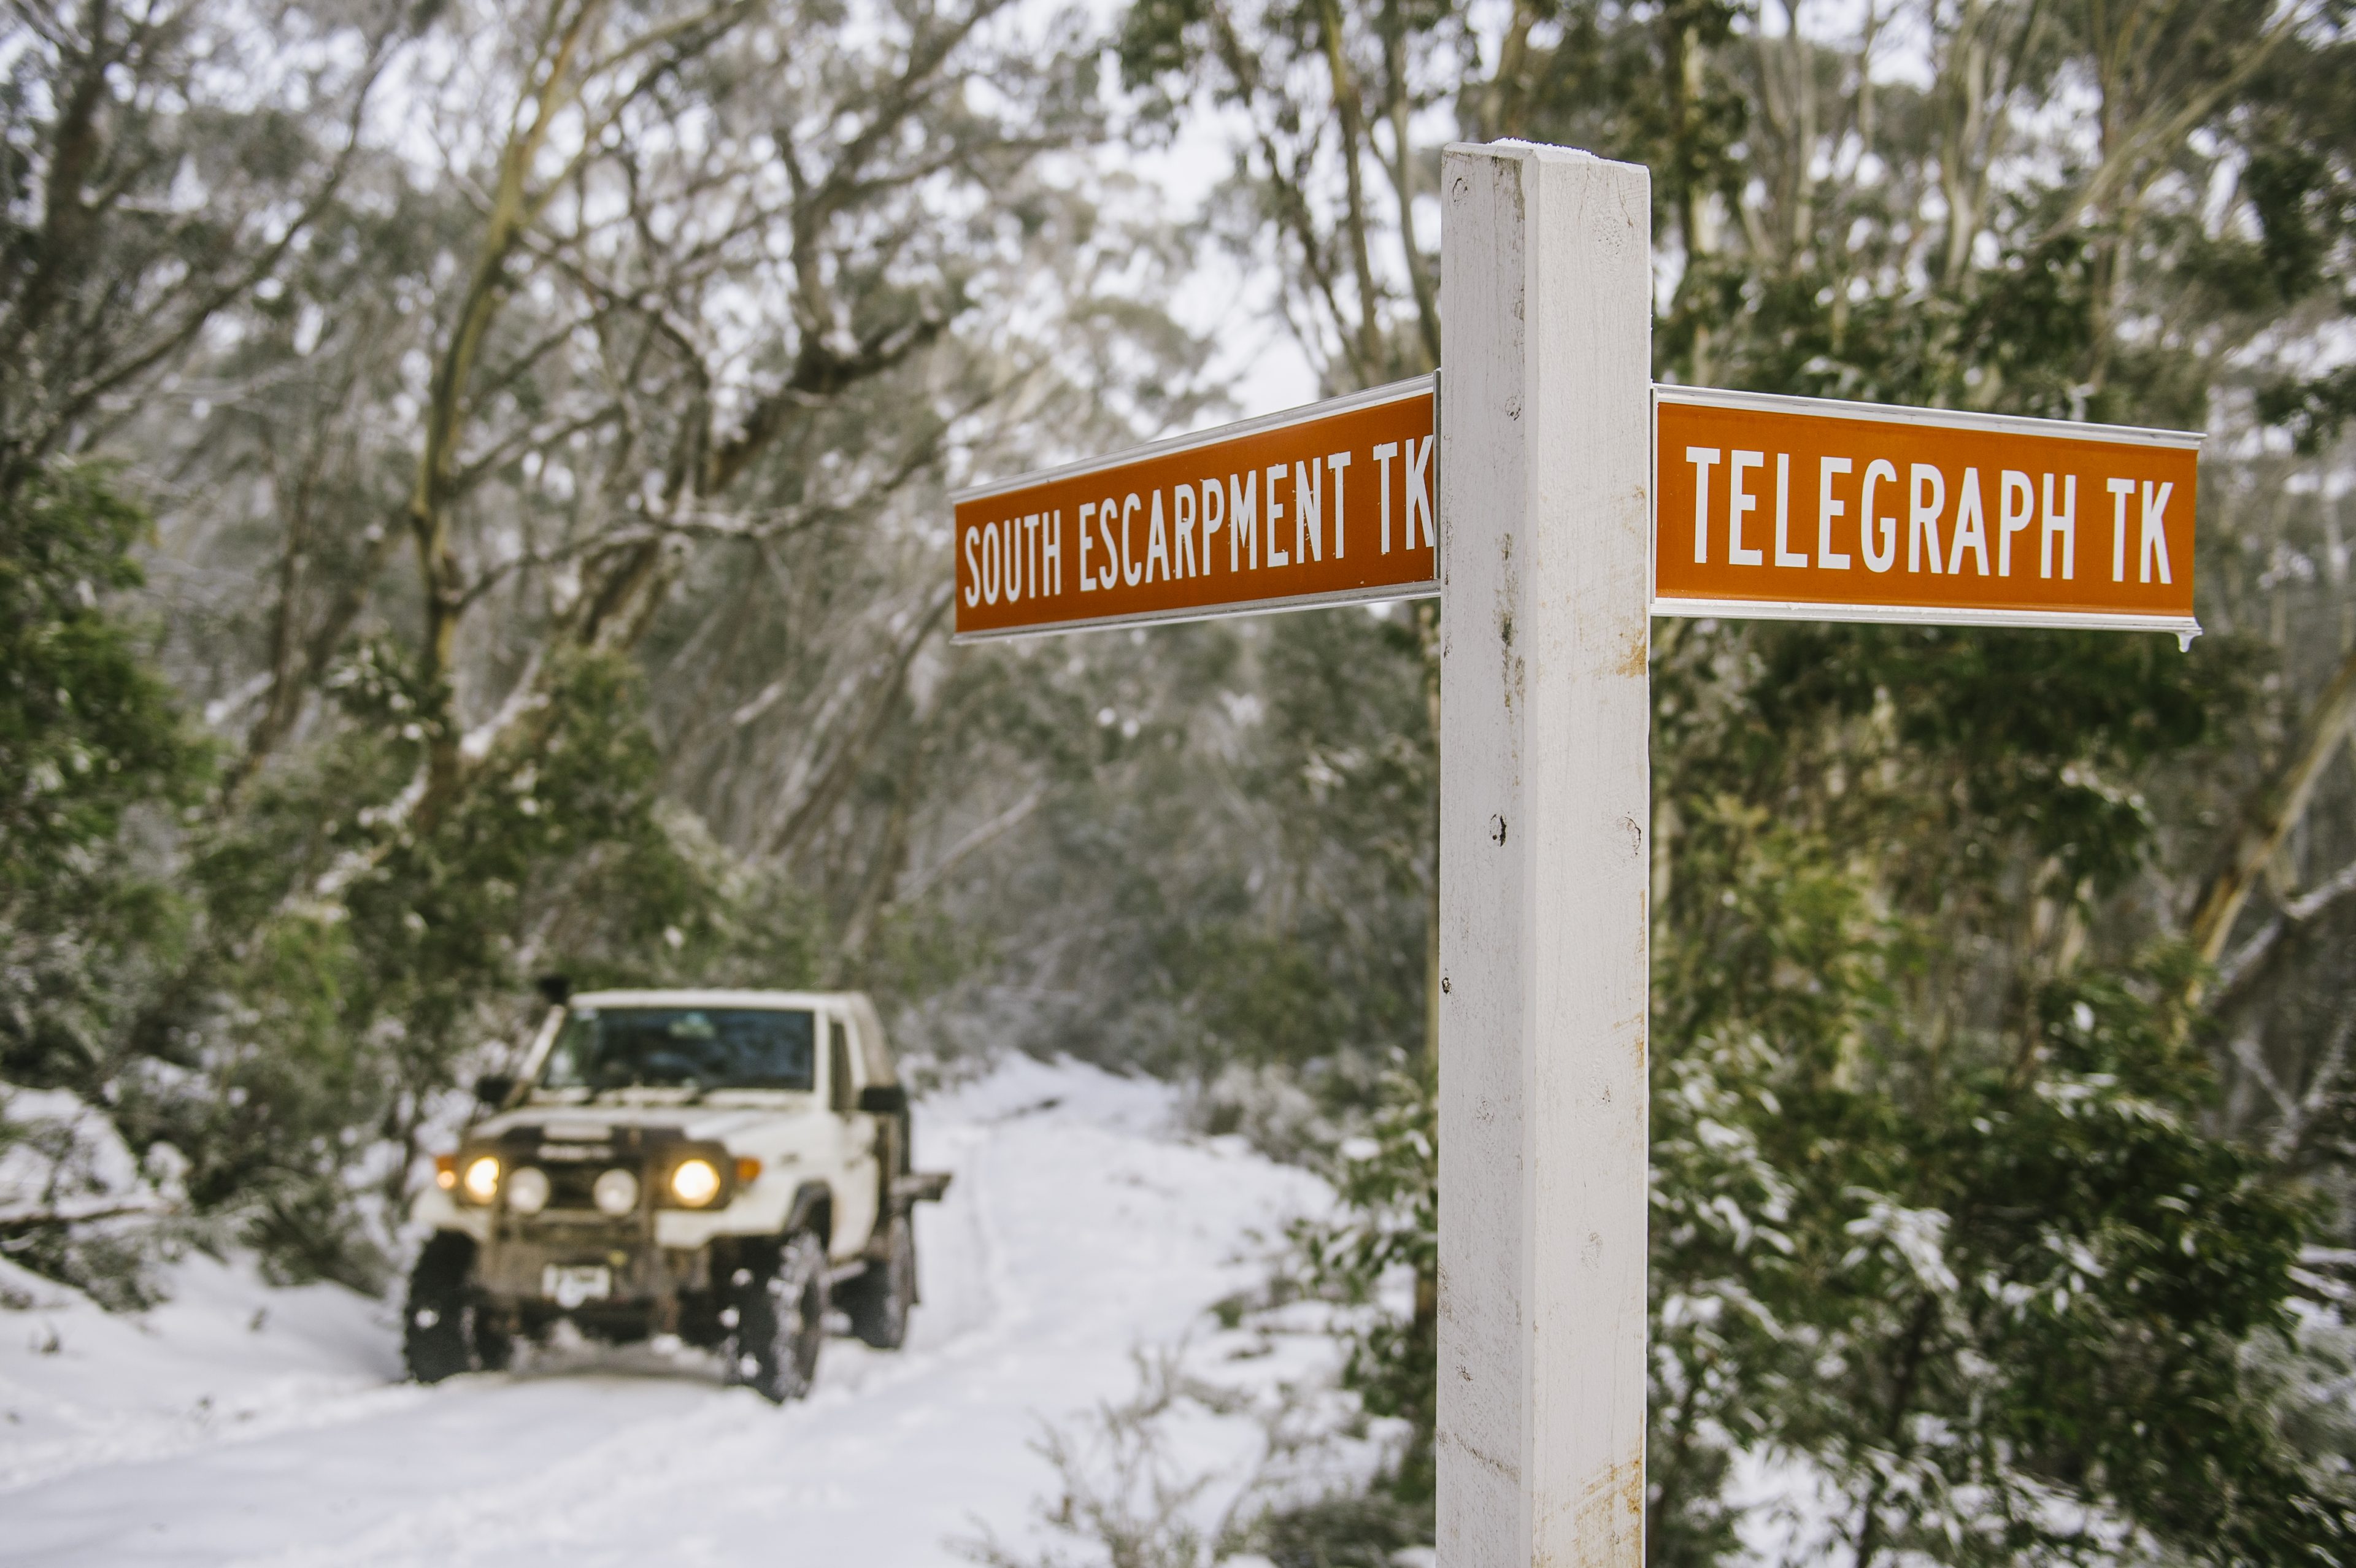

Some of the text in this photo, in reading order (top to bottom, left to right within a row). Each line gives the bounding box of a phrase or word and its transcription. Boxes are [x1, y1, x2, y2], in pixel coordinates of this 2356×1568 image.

[964, 435, 1434, 609] SOUTH ESCARPMENT TK
[1685, 446, 2174, 585] TELEGRAPH TK
